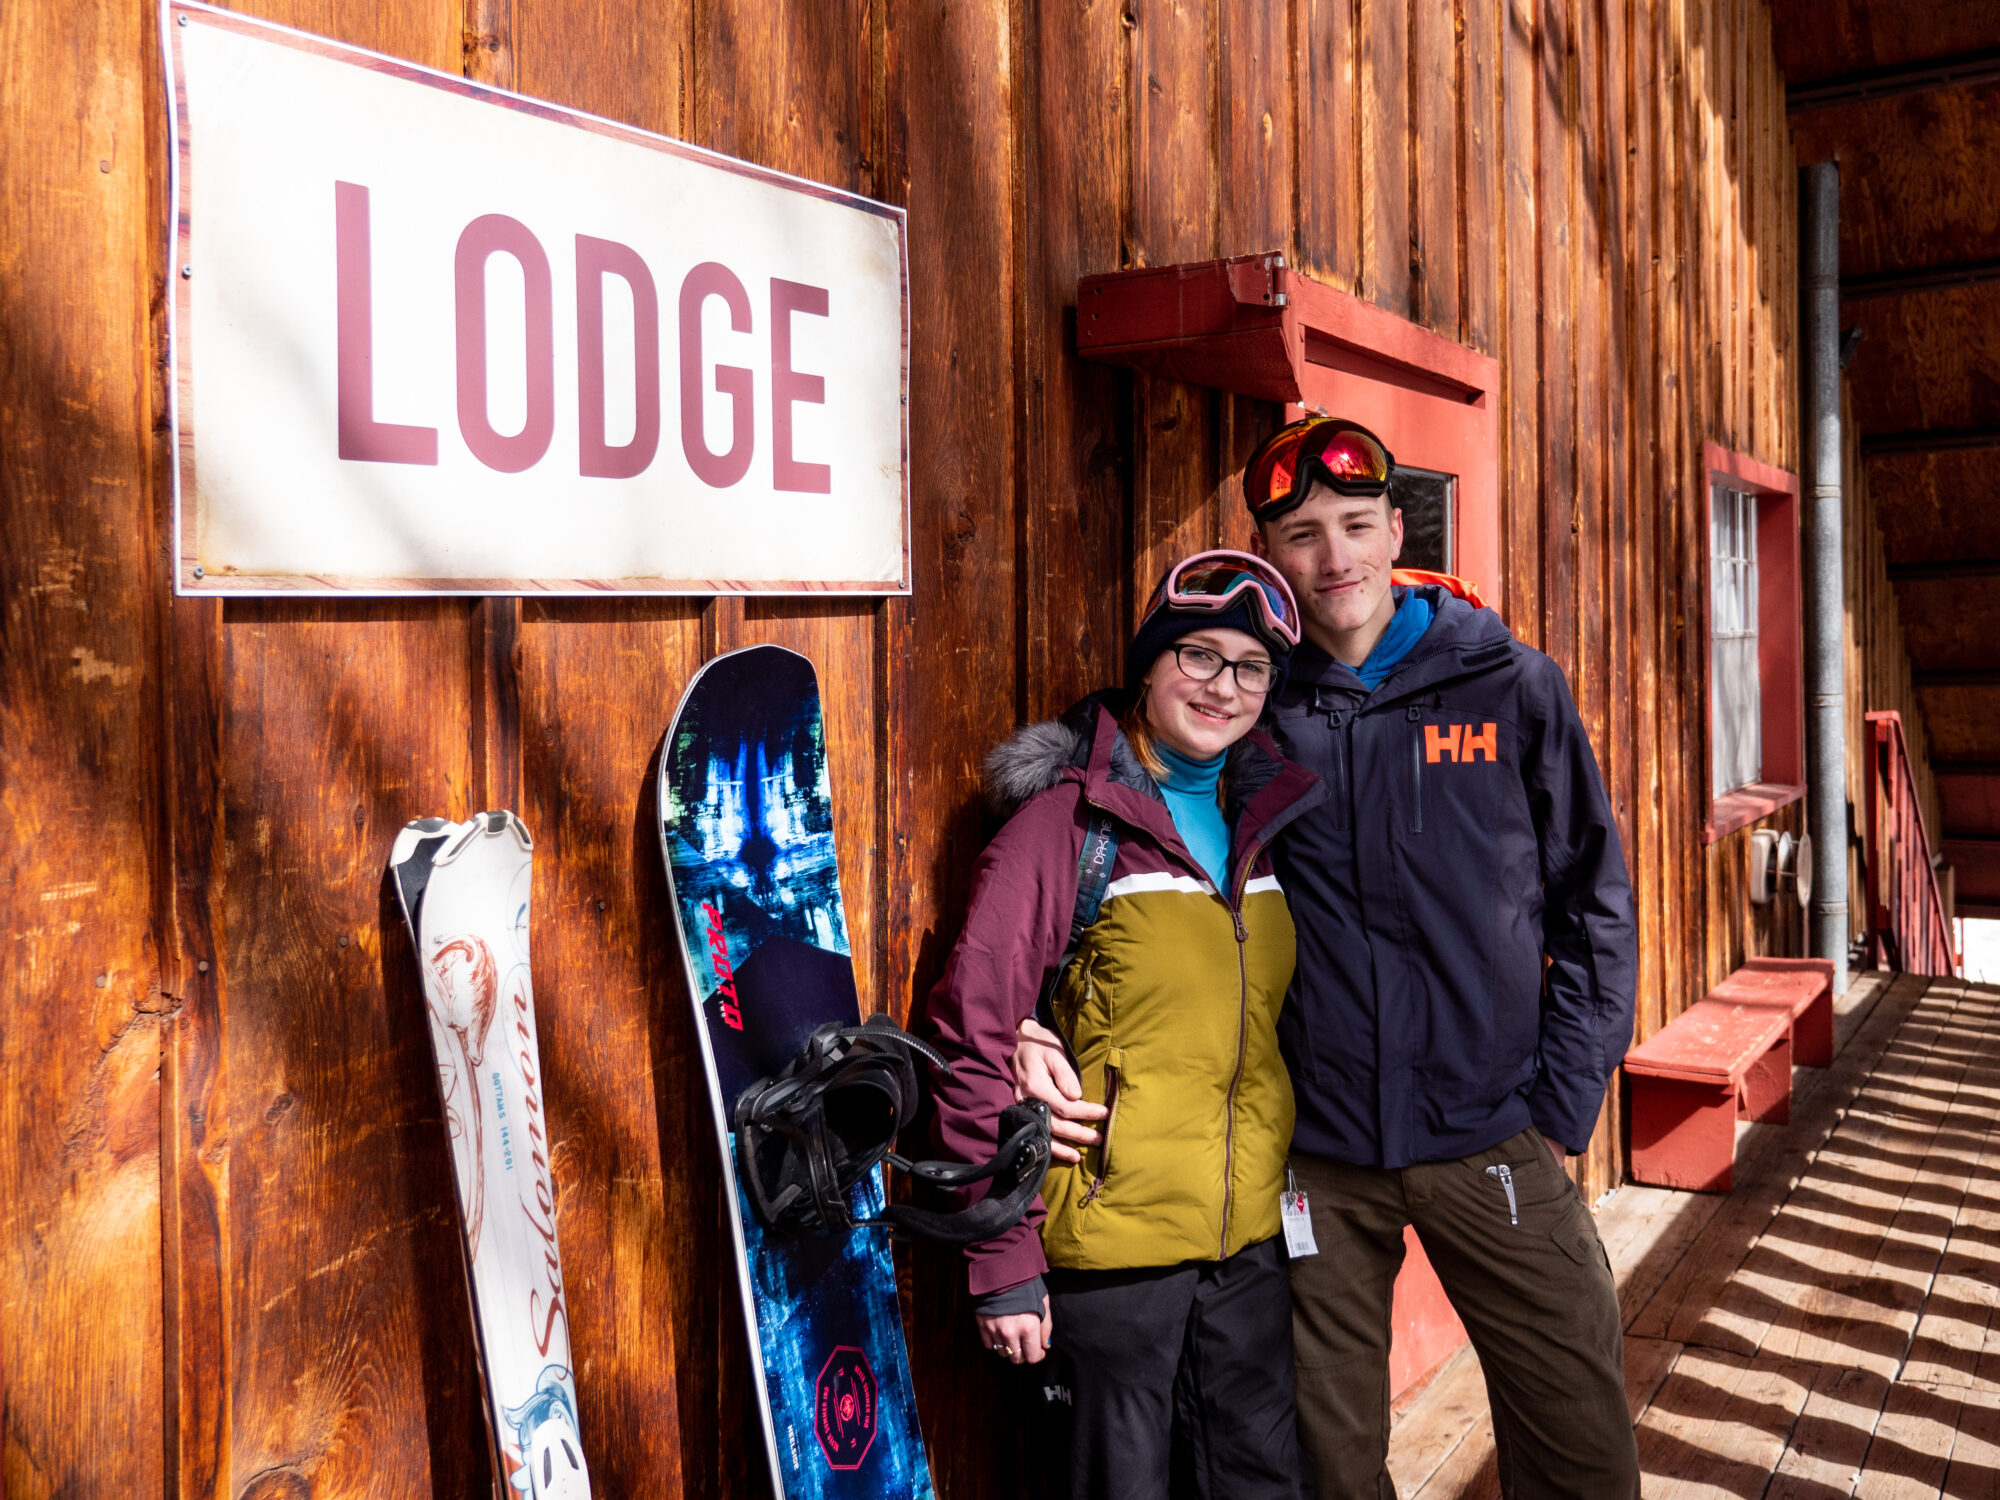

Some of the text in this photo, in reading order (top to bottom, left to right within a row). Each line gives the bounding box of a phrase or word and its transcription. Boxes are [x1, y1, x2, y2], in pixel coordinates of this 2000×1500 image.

[335, 180, 831, 494] LODGE
[1424, 723, 1497, 763] HH
[702, 902, 744, 1031] PROTO
[514, 978, 570, 1381] Salomon
[1044, 1385, 1072, 1406] HH
[788, 1424, 799, 1470] HEELSIDE
